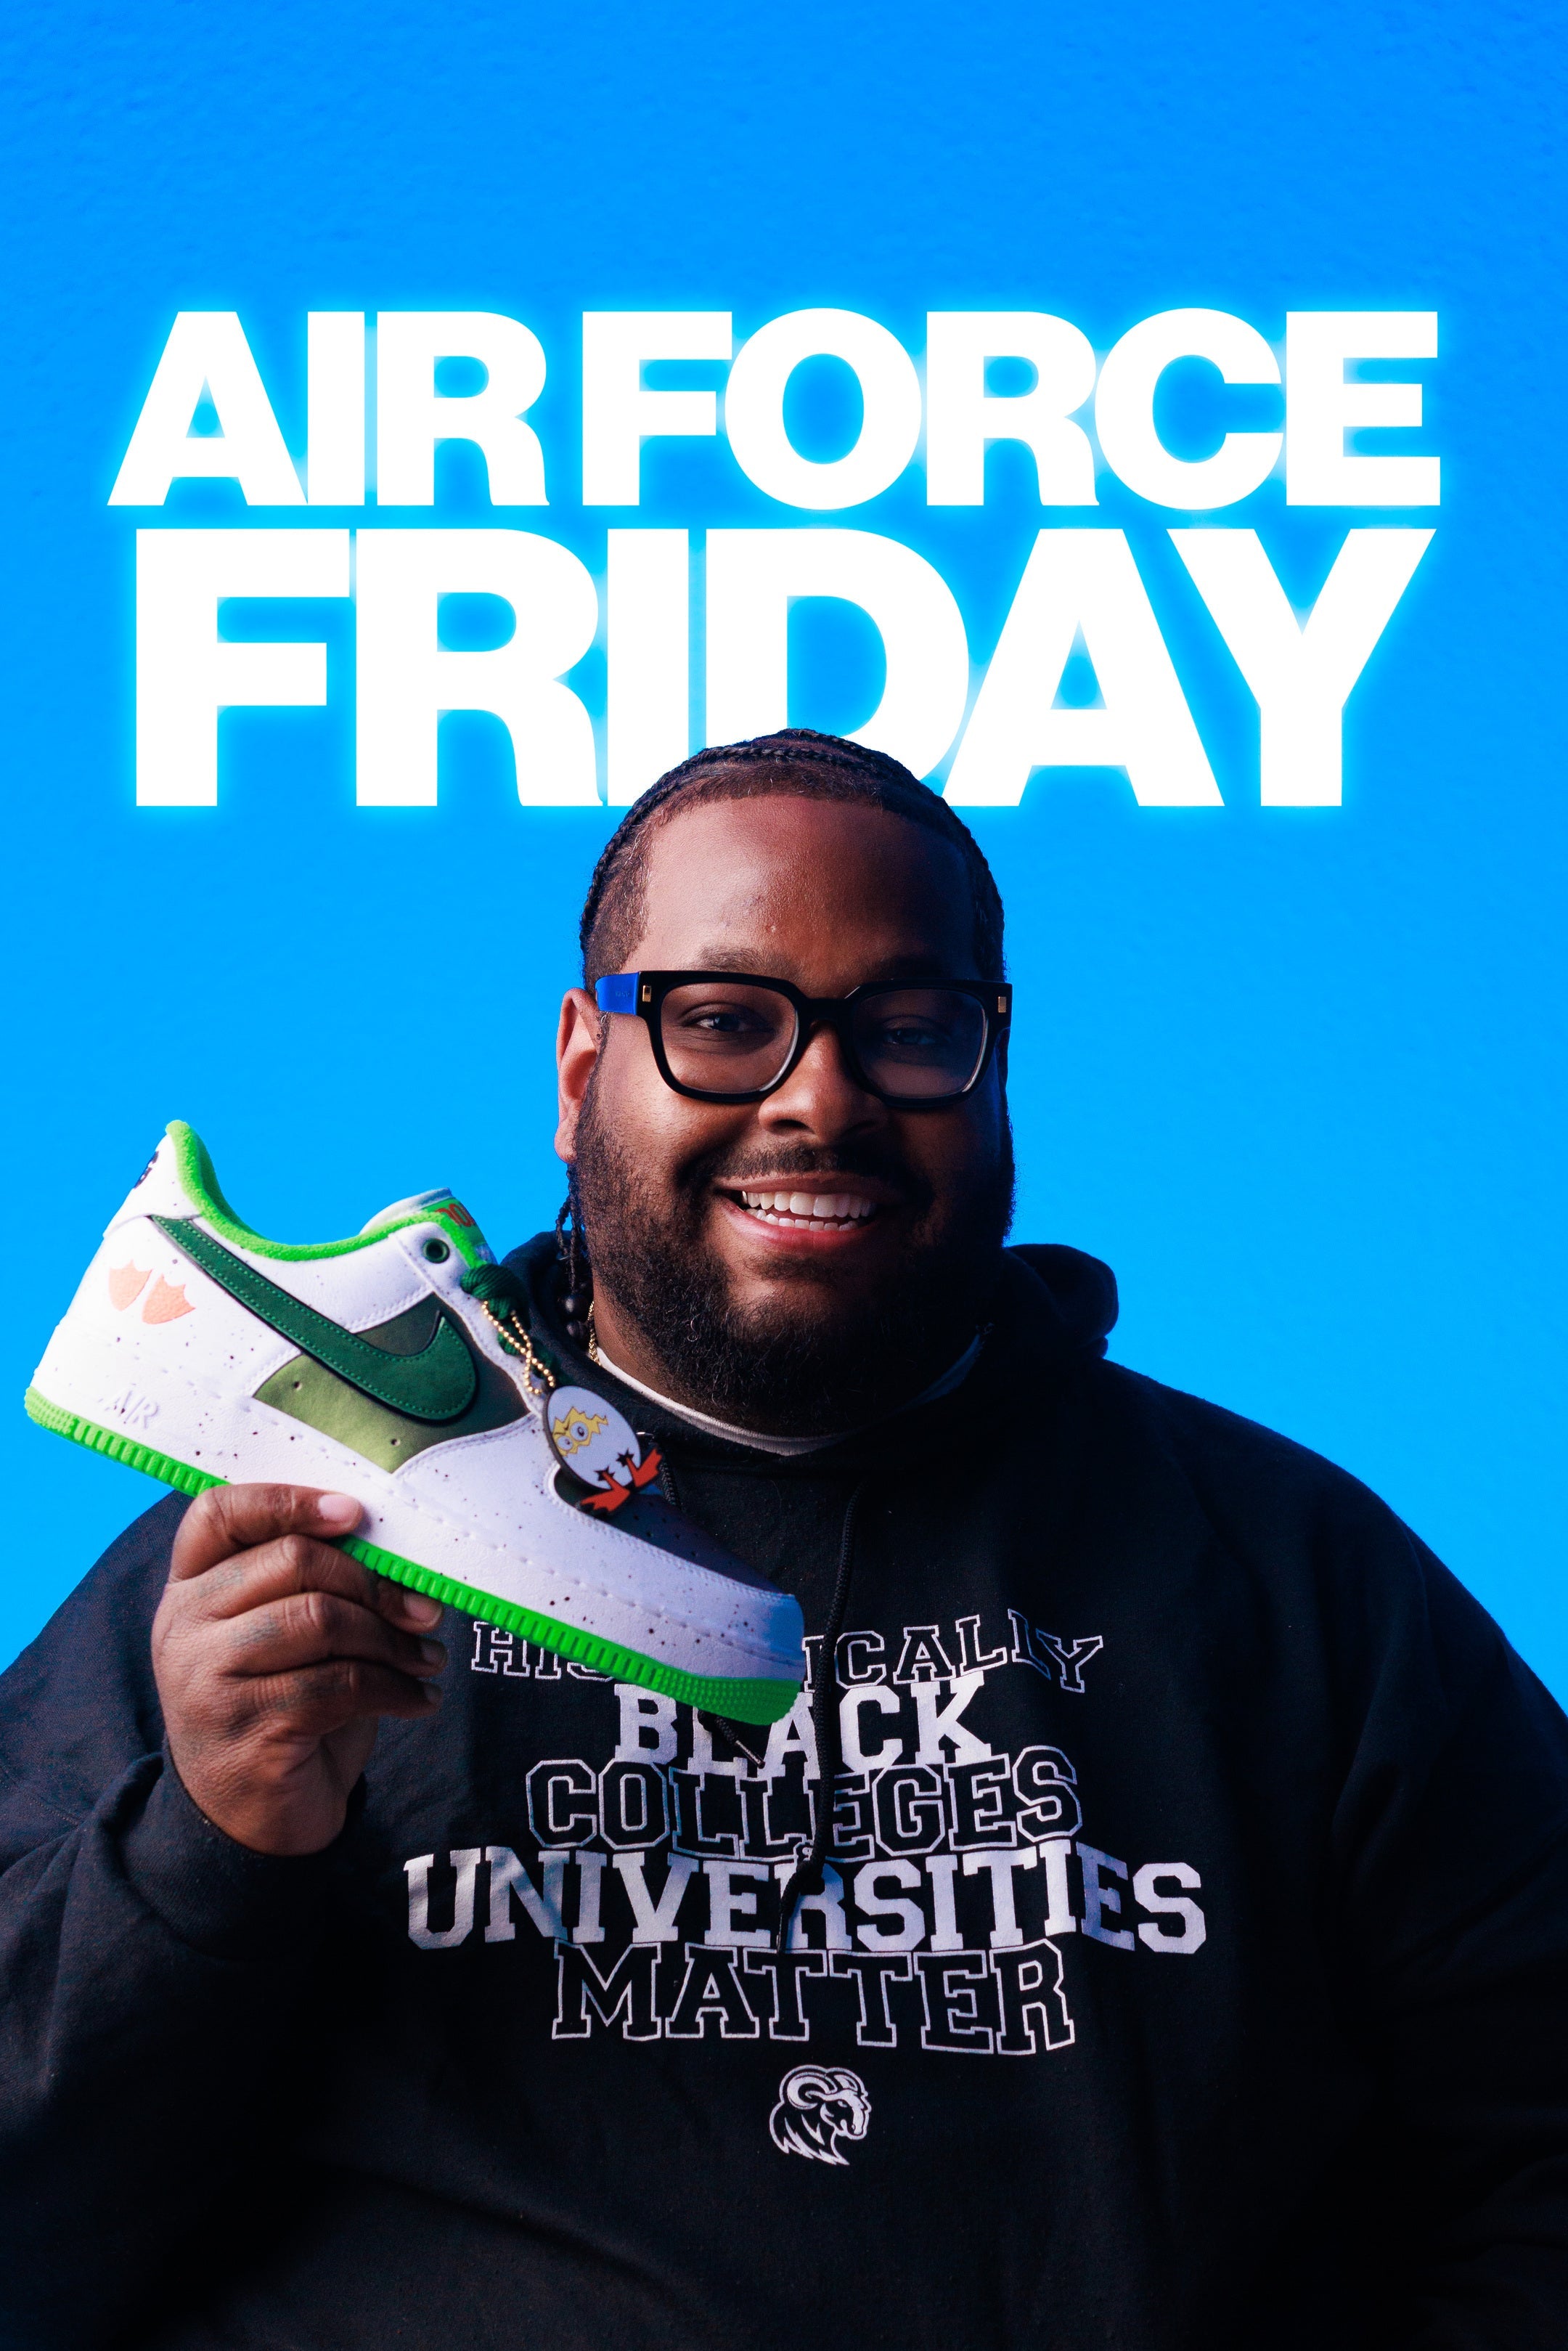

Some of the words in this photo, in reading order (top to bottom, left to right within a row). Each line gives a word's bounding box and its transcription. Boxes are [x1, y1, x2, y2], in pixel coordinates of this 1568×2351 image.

[99, 1388, 160, 1429] AIR
[614, 1671, 992, 1780] BLACK
[526, 1745, 1082, 1863] COLLEGES
[404, 1839, 1206, 1954] UNIVERSITIES
[552, 1939, 1074, 2055] MATTER
